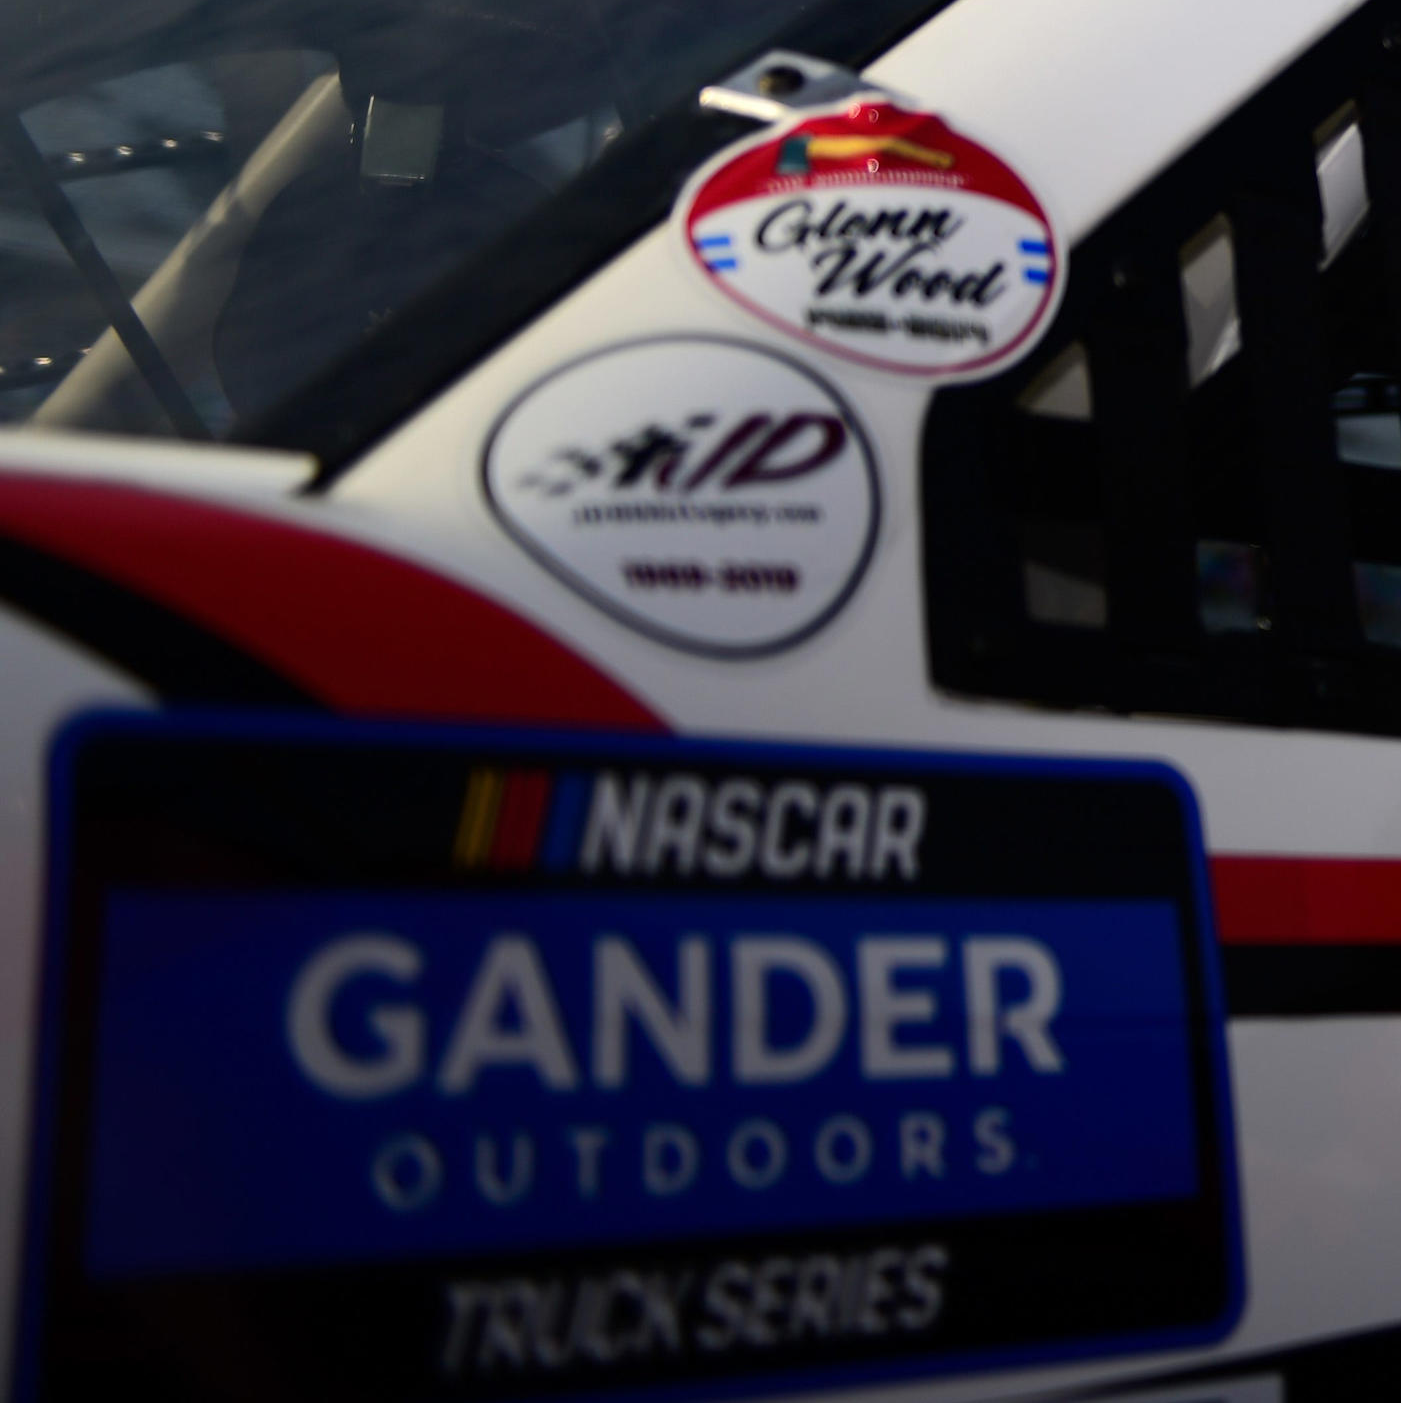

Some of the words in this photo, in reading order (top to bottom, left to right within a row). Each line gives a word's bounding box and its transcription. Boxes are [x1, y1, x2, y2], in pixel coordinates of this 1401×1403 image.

[757, 198, 965, 254] Glenn
[812, 242, 1006, 308] Wood
[582, 771, 925, 882] NASCAR
[287, 932, 1065, 1098] GANDER
[373, 1109, 1018, 1209] OUTDOORS
[442, 1269, 695, 1373] TRUCK
[695, 1243, 949, 1351] SERIES
